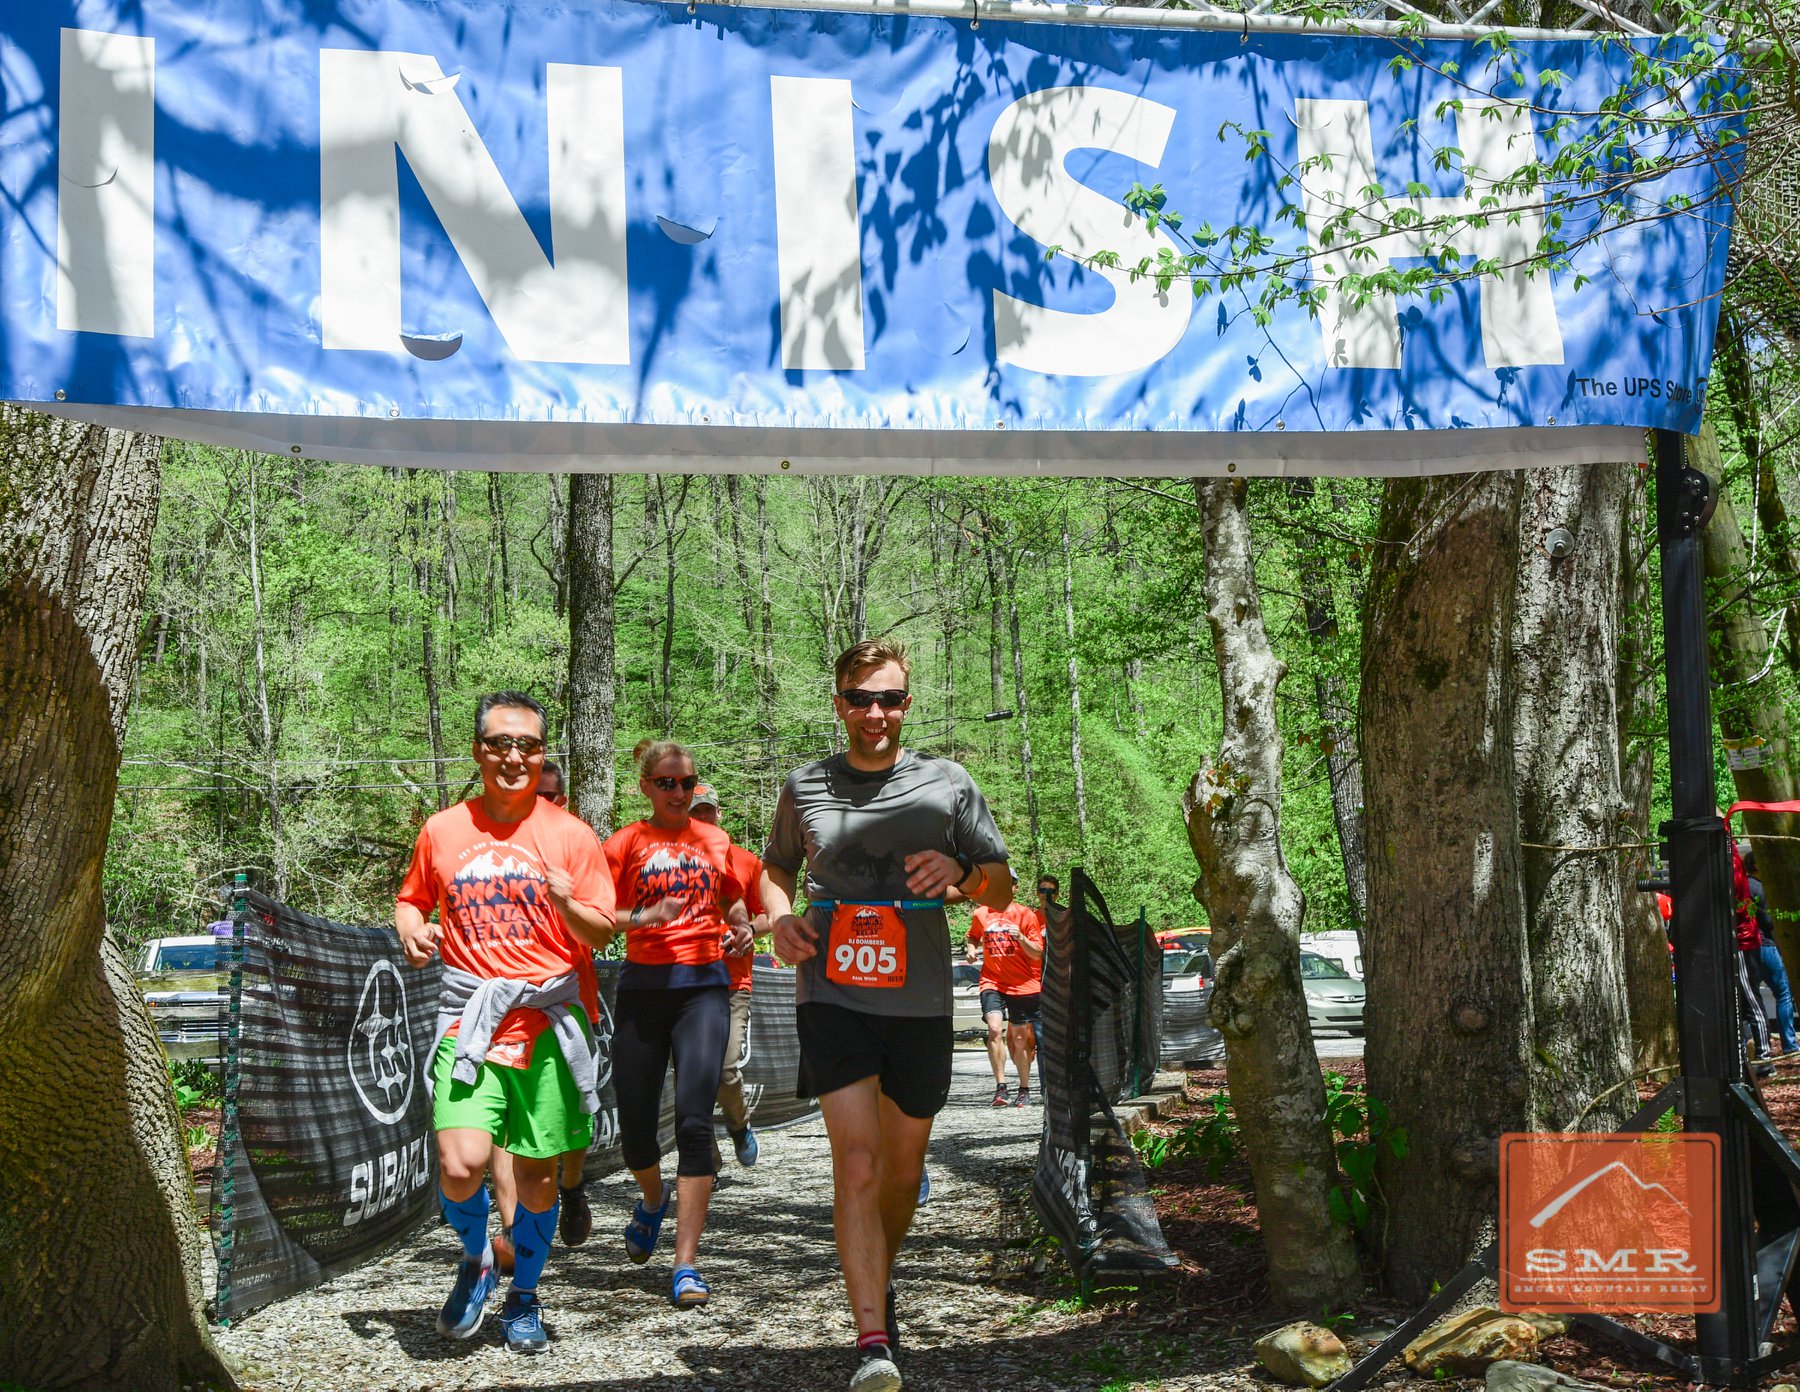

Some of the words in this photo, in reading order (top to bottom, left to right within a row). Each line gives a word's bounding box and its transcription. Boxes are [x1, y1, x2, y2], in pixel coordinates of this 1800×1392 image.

[57, 27, 1565, 377] INISH
[1576, 377, 1618, 397] The
[1624, 376, 1661, 398] UPS
[1666, 380, 1692, 404] Store
[446, 877, 549, 910] SMOKY
[636, 868, 718, 899] SMOKY
[462, 922, 533, 942] RELAY
[835, 944, 896, 974] 905
[343, 1131, 429, 1227] SUBARU
